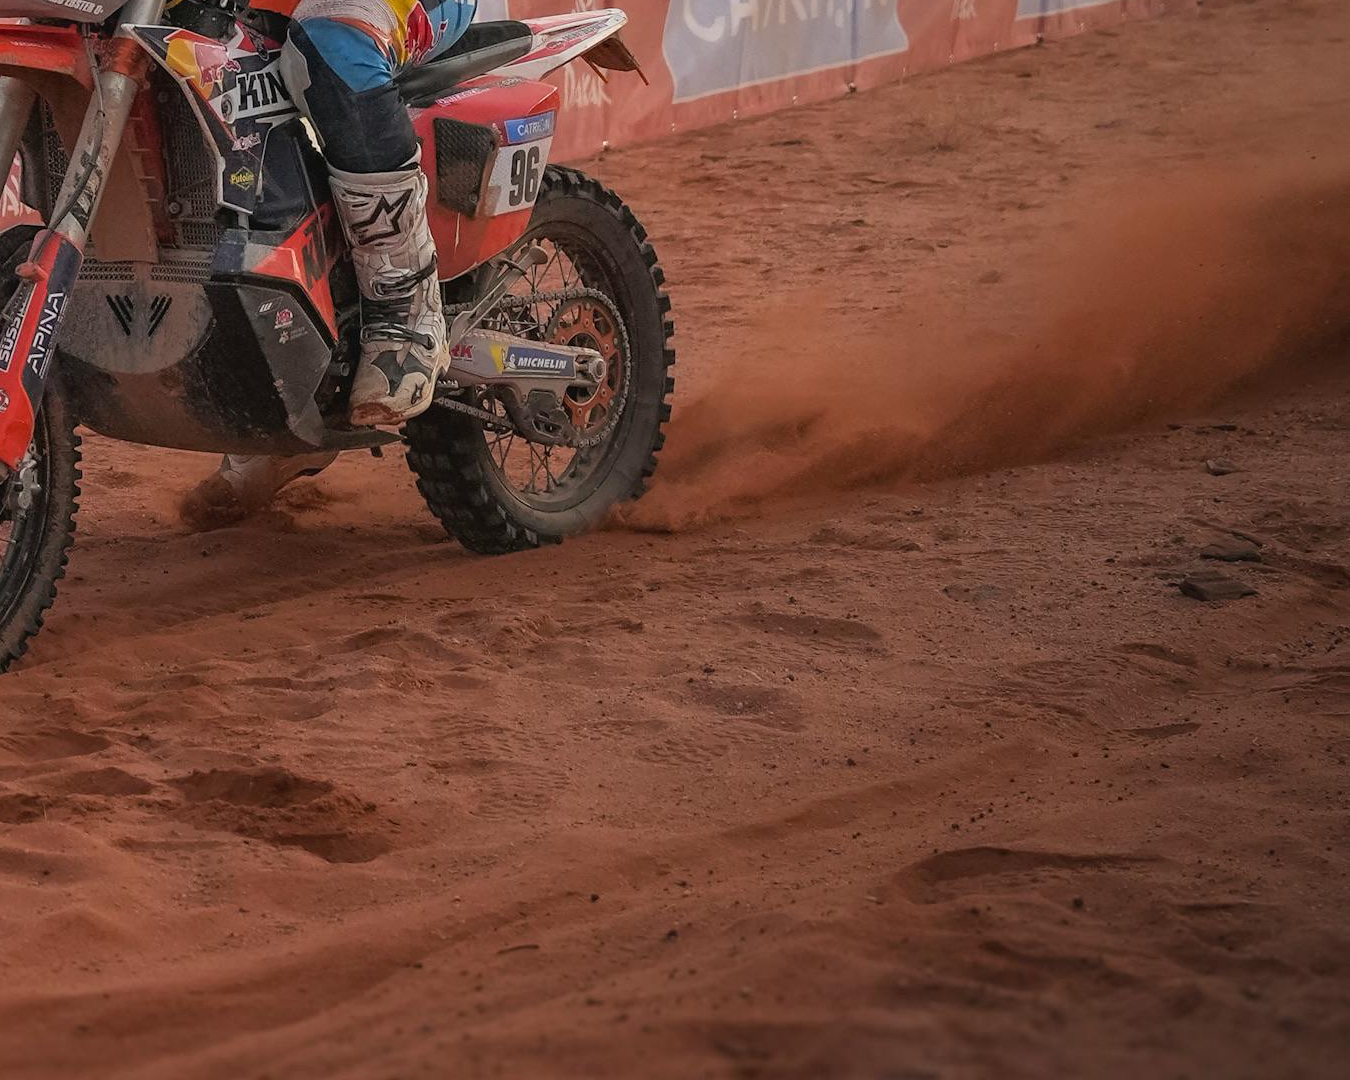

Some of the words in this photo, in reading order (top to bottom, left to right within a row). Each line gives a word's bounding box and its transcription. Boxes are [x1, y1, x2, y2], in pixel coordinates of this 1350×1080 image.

[238, 70, 290, 112] KIN
[508, 146, 540, 207] 96
[517, 357, 567, 370] MICHELIN
